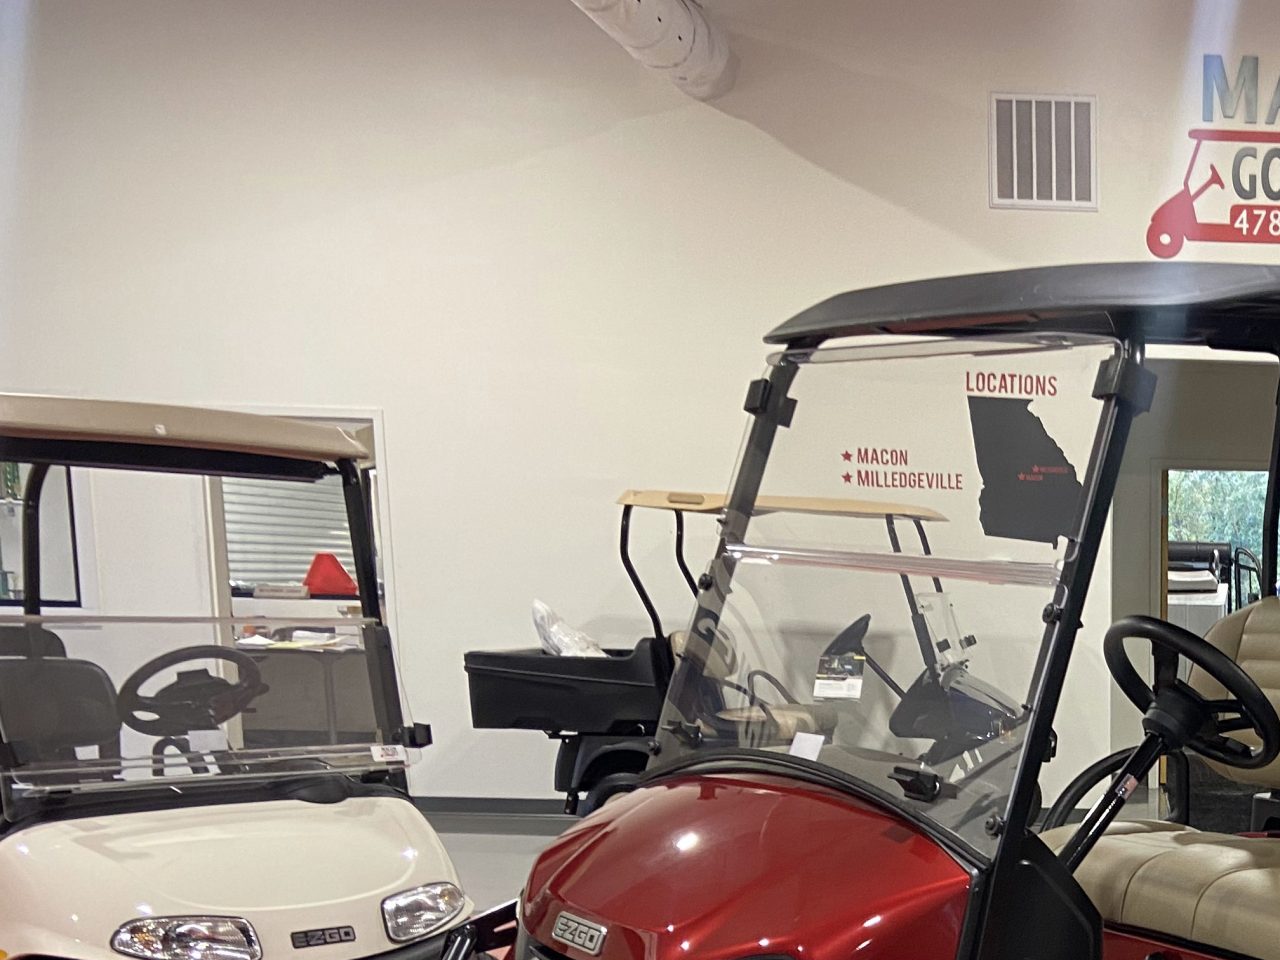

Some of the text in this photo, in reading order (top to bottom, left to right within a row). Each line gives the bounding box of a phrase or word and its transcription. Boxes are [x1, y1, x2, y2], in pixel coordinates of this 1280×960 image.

[966, 371, 1058, 396] LOCATIONS
[857, 448, 908, 466] MACON
[857, 470, 963, 490] MILLEDGEVILLE
[291, 926, 356, 948] EZGO
[554, 914, 603, 951] EZGO
